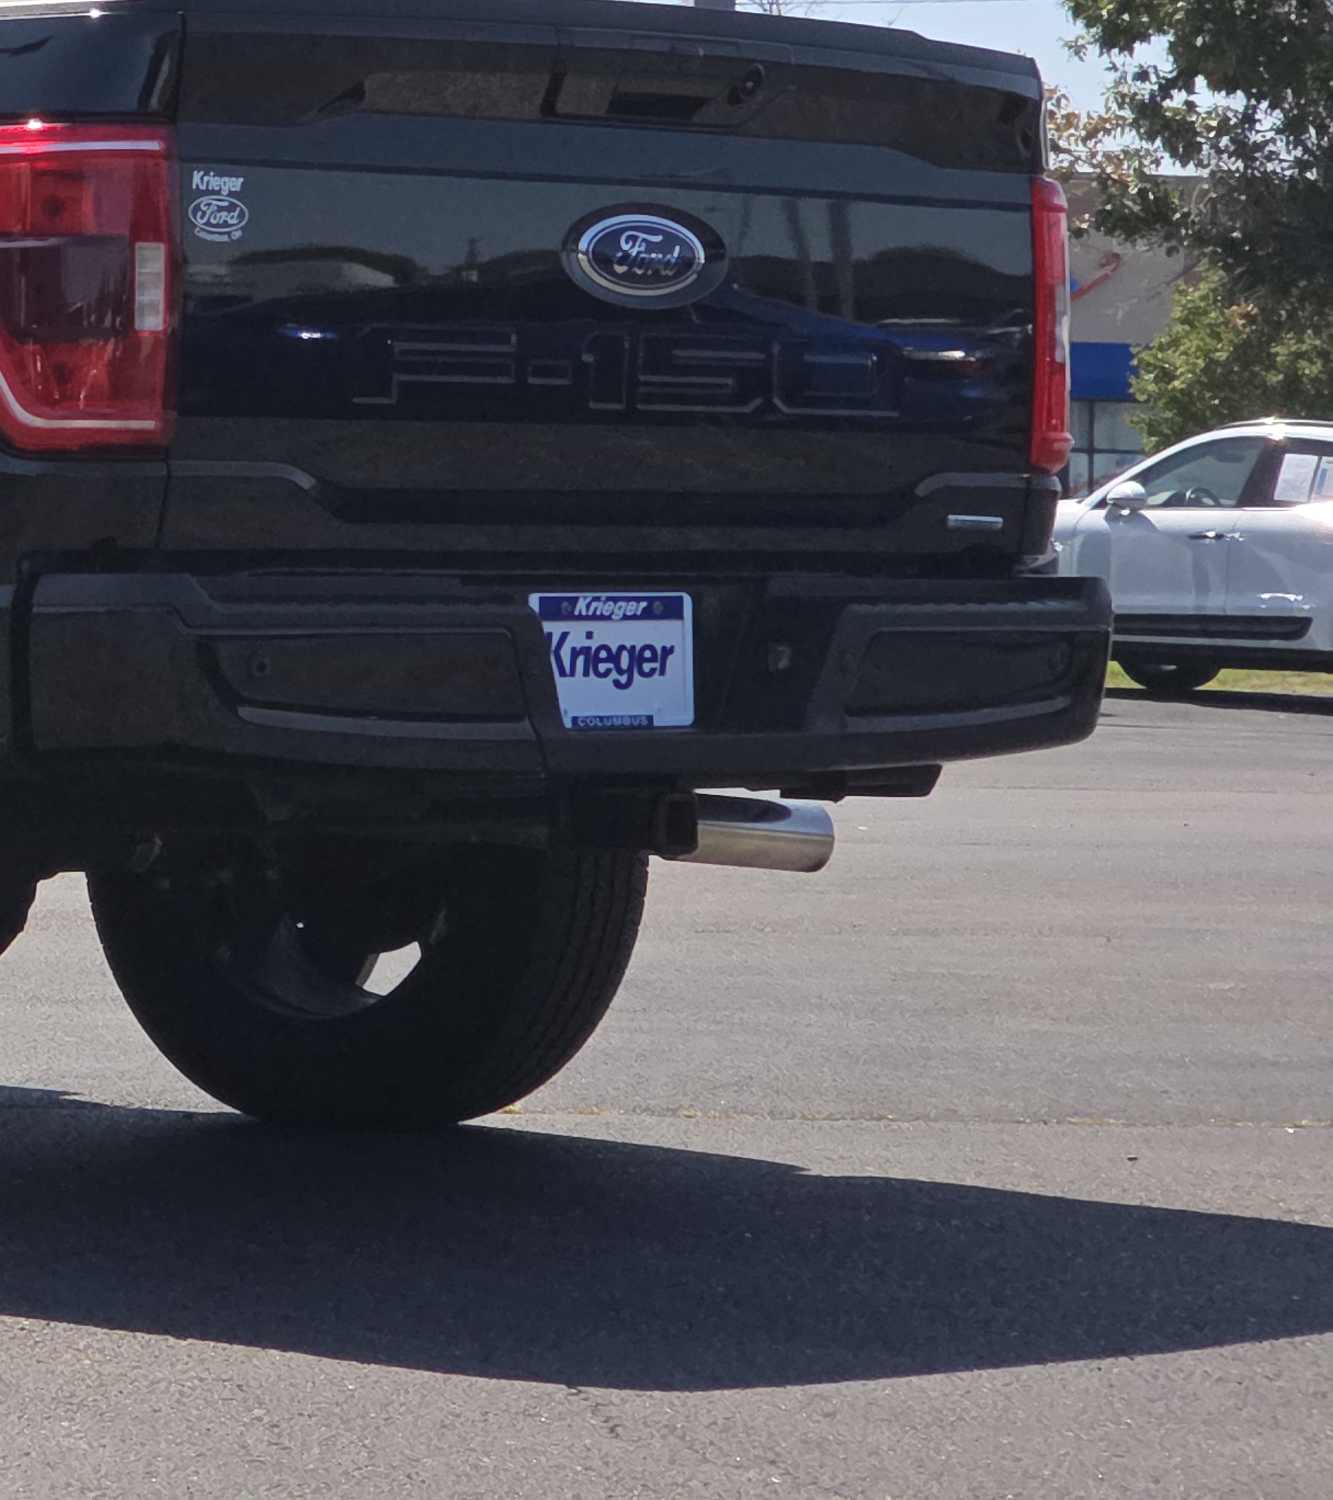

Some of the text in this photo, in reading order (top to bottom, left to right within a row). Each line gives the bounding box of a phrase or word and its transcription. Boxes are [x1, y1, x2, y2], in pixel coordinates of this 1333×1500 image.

[192, 170, 244, 195] Krieger
[196, 200, 240, 225] Ford
[613, 230, 680, 276] Ford
[351, 323, 901, 417] F-150
[574, 596, 648, 620] Krieger
[545, 630, 675, 690] Krieger
[577, 717, 649, 726] COLUMBUS
